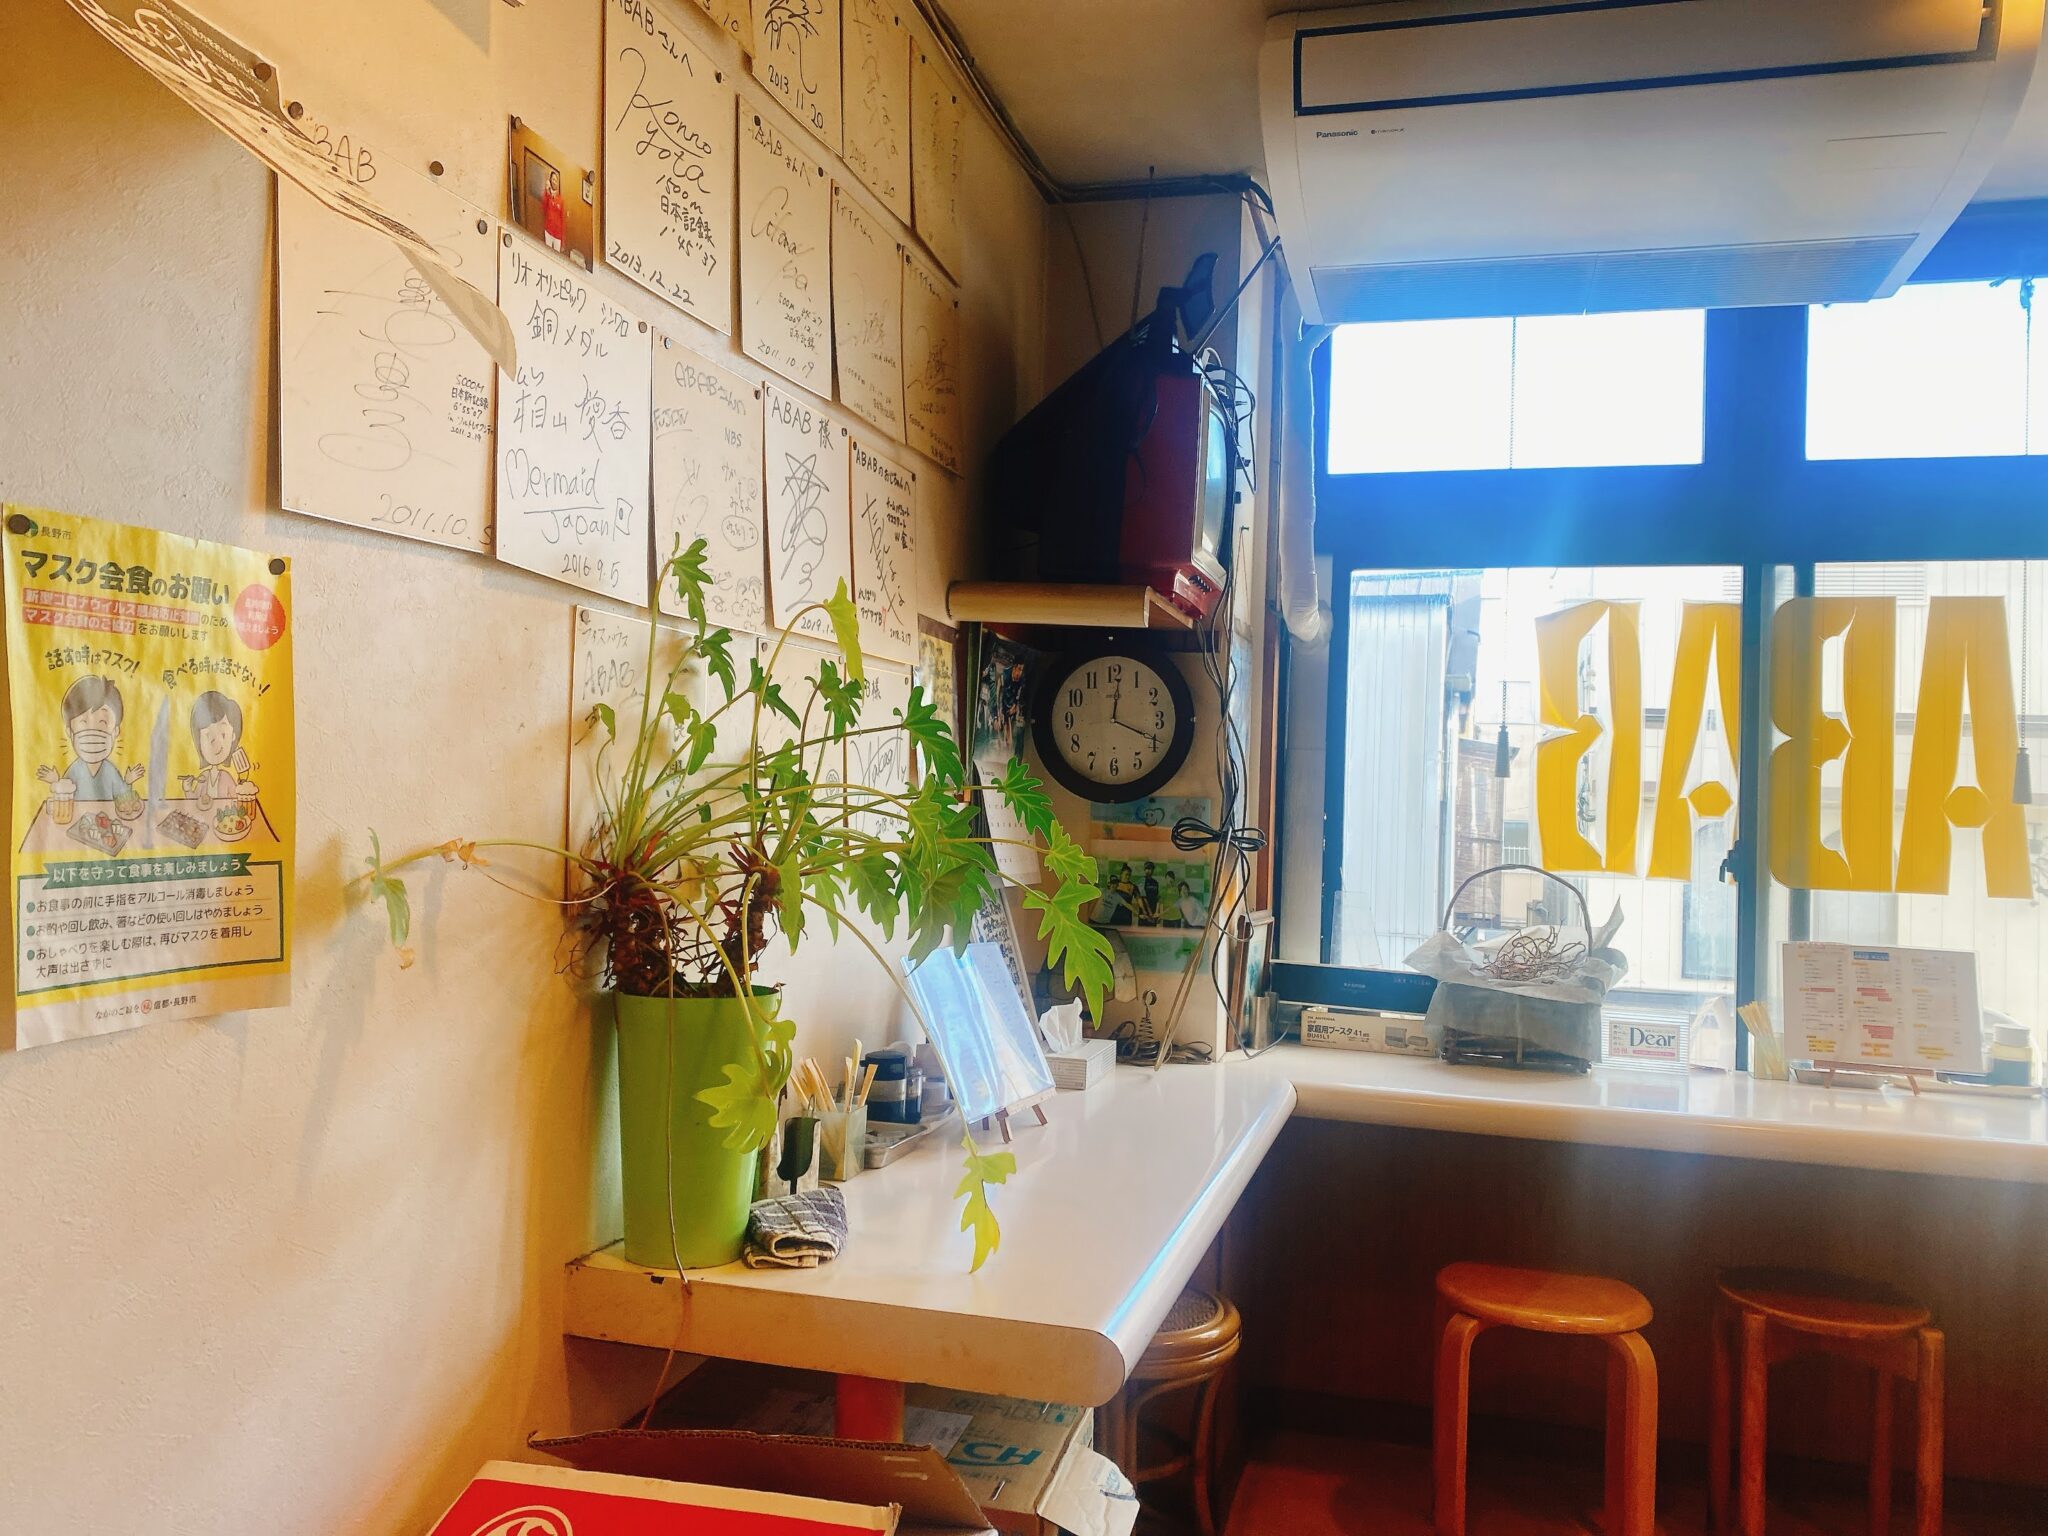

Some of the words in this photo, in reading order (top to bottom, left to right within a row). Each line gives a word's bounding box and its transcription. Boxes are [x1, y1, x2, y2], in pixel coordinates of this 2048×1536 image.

[1316, 130, 1358, 138] Panasonic
[609, 241, 694, 306] 2013.12.22
[526, 299, 608, 358] 銅メダル
[771, 395, 812, 435] ABAB
[819, 418, 834, 450] 様
[724, 427, 742, 448] NBS
[41, 527, 72, 540] 長野市
[21, 549, 230, 606] マスク会食のお願い
[583, 651, 635, 701] ABAB
[1086, 672, 1099, 689] 11
[1107, 664, 1122, 683] 12
[1134, 671, 1140, 688] 1
[1068, 688, 1083, 708] 10
[1149, 687, 1159, 706] 2
[1064, 711, 1074, 730] 9
[1155, 710, 1165, 730] 3
[1071, 734, 1080, 753] 8
[1148, 734, 1160, 753] 4
[1088, 752, 1097, 771] 7
[1110, 758, 1119, 777] 6
[1133, 752, 1143, 771] 5
[52, 859, 242, 883] 以下を守って食事を楽しみましょう
[36, 885, 255, 913] お食事の前に手指をアルコール消毒しましょう
[1307, 1024, 1353, 1036] 家庭用ブースタ
[1630, 1027, 1676, 1047] Dear
